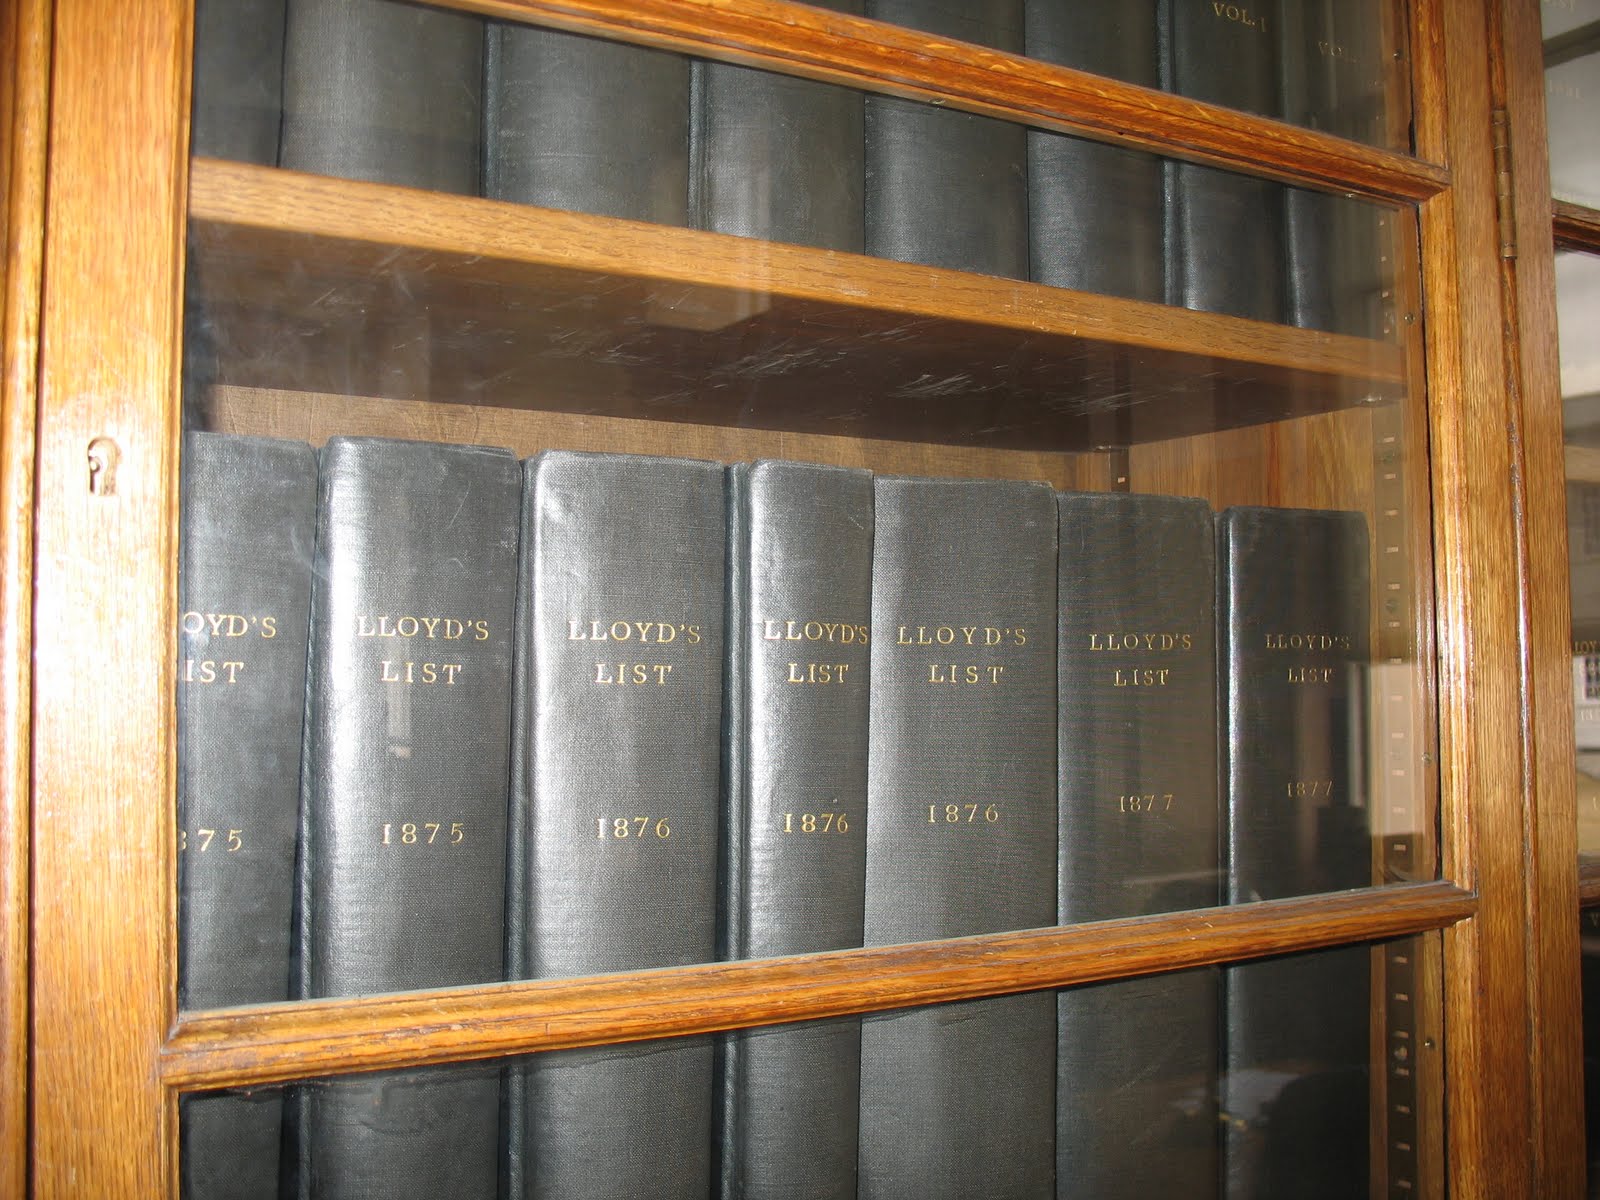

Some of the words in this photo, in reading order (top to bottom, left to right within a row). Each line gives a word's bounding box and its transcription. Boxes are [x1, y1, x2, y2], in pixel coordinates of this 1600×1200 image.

[1212, 2, 1256, 26] VOL.
[357, 615, 490, 641] LLOYD'S
[567, 620, 702, 644] LLOYD'S
[763, 620, 869, 645] LLOYD'S
[896, 626, 1028, 646] LLOYD'S
[1088, 633, 1193, 651] LLOYD'S
[1264, 633, 1351, 650] LLOYD'S
[381, 660, 462, 685] LIST
[594, 663, 673, 685] LIST
[787, 662, 849, 684] LIST
[928, 664, 1004, 685] LIST
[1113, 669, 1170, 687] LIST
[1287, 668, 1334, 684] LIST
[1286, 780, 1333, 798] 1877
[927, 803, 1000, 823] 1876
[1118, 794, 1174, 813] 1877
[381, 823, 465, 845] 1875
[596, 817, 672, 839] 1876
[783, 813, 850, 834] 1876
